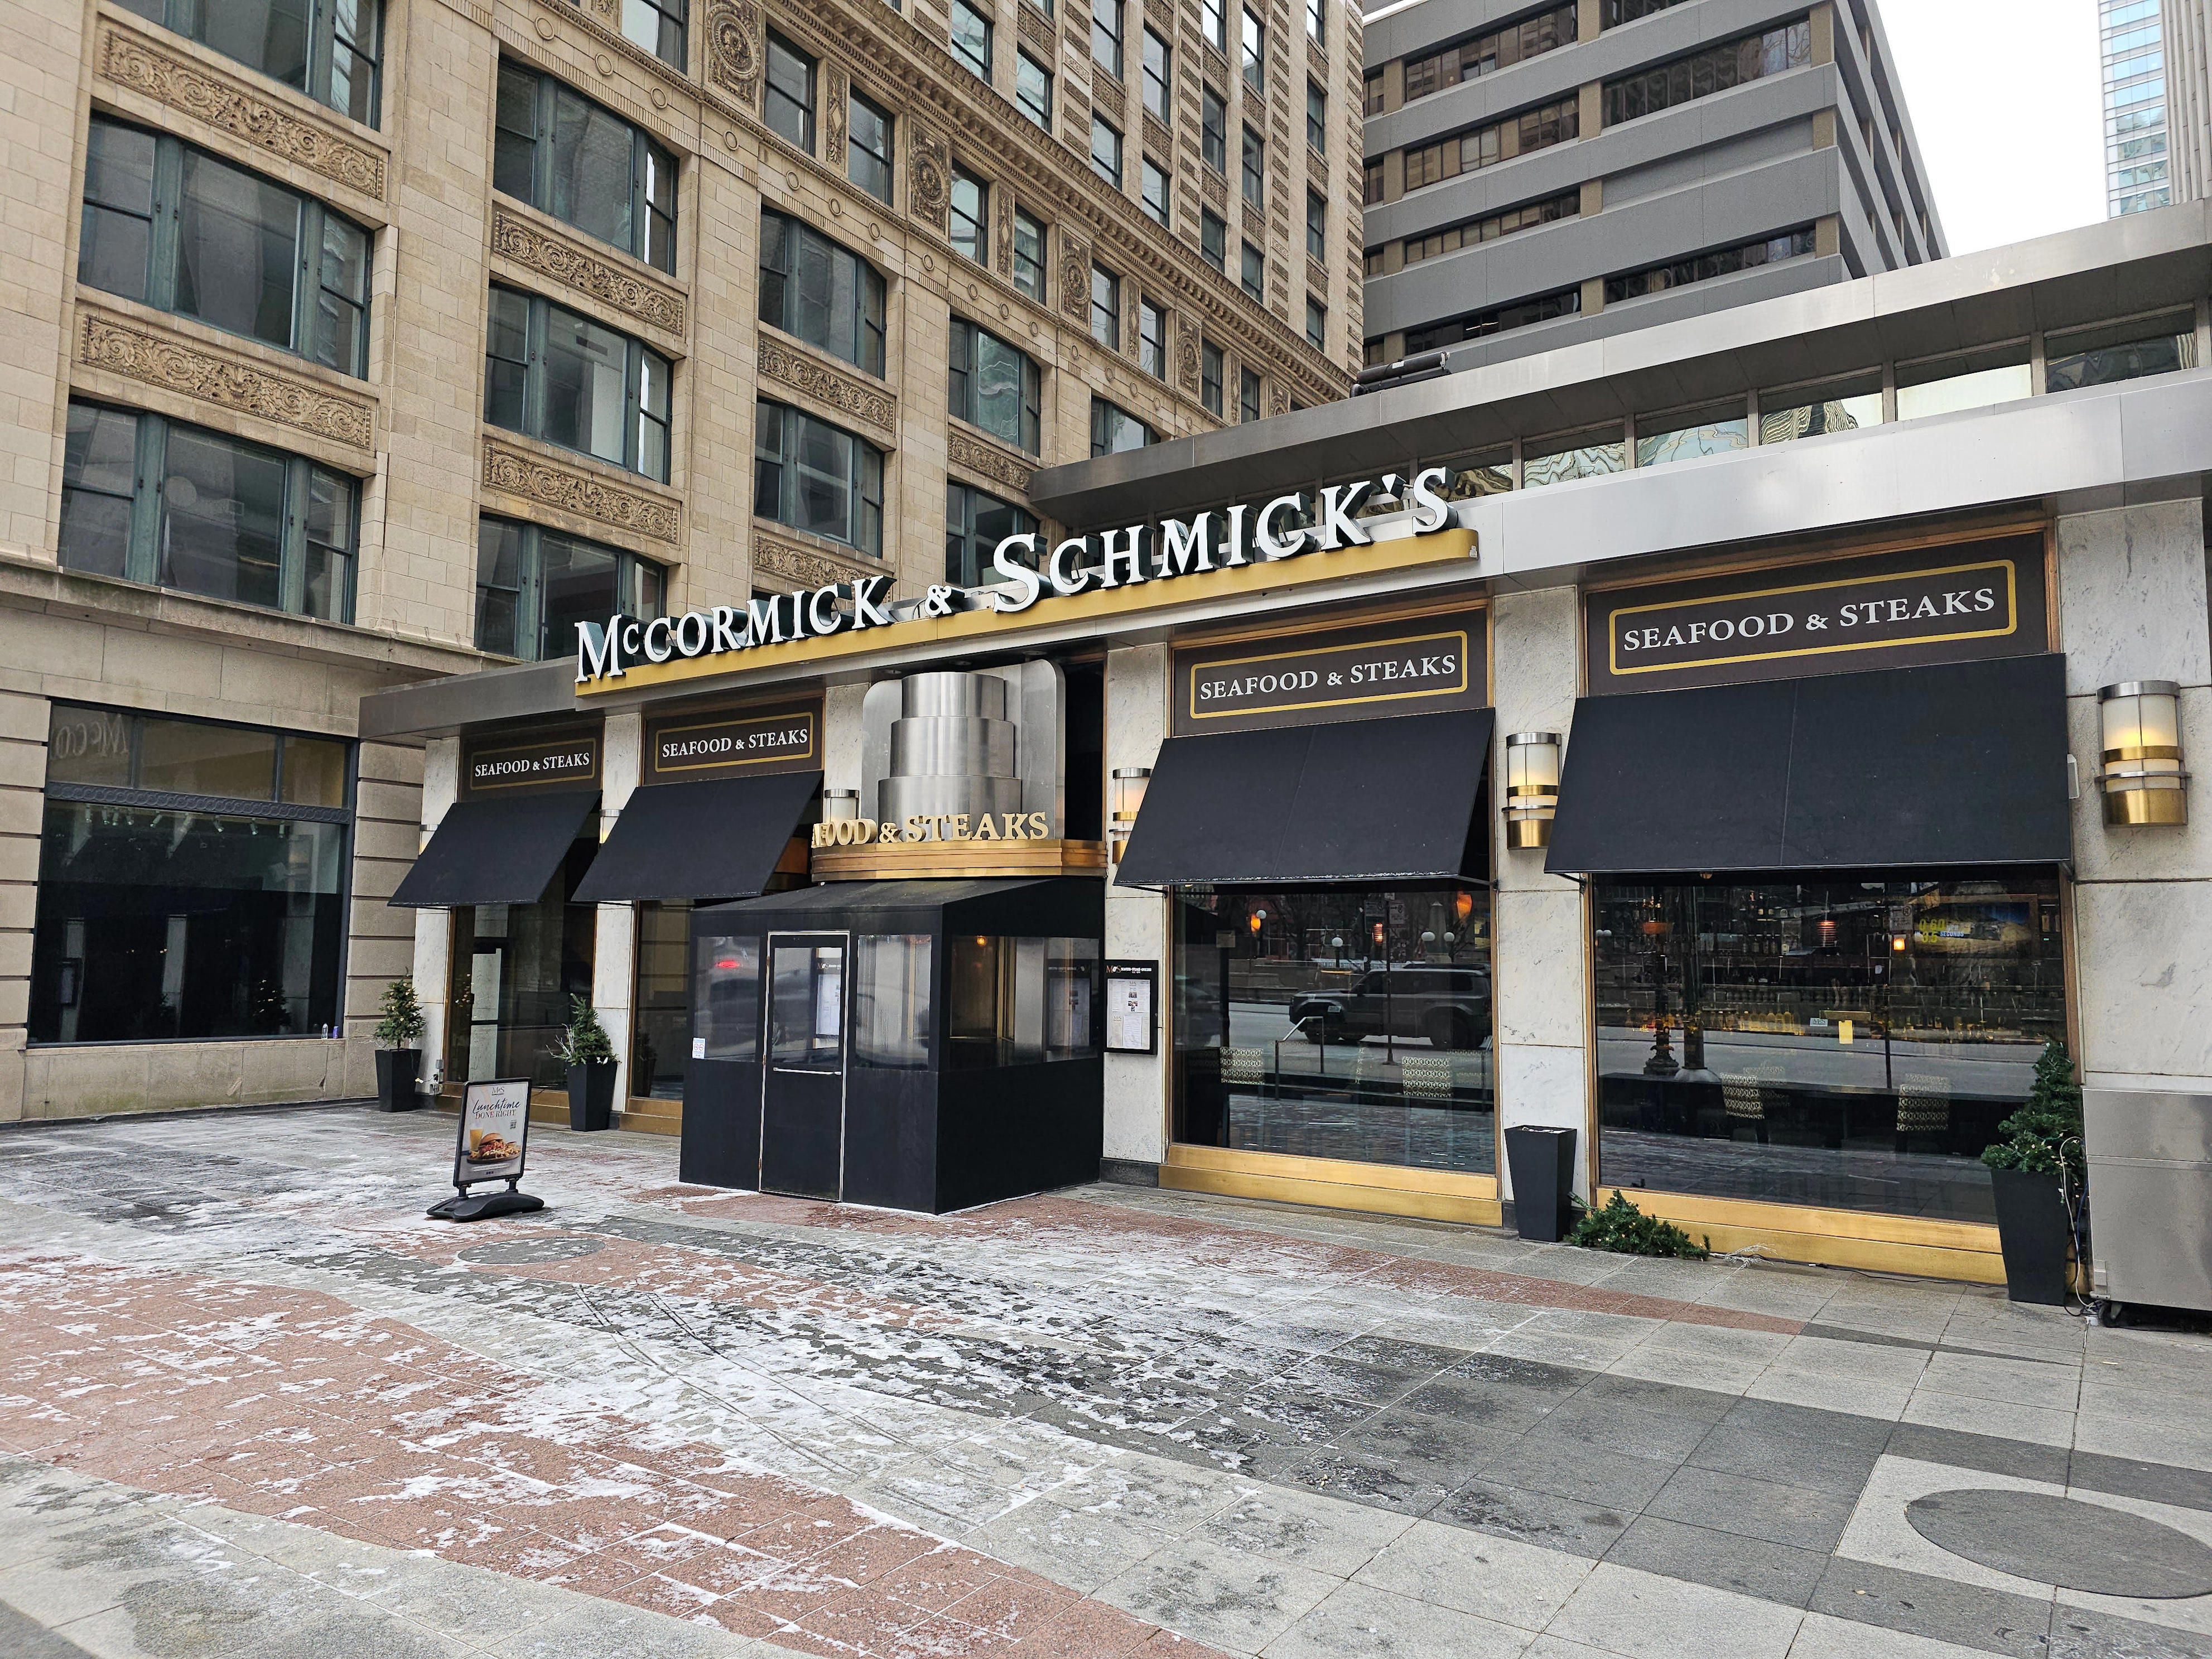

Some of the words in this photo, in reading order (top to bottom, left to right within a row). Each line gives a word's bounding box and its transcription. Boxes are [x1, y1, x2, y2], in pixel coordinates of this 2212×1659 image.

[924, 583, 953, 618] &
[992, 466, 1450, 614] SCHMICK'S
[1624, 613, 1792, 652] SEAFOOD
[1806, 614, 1829, 630] &
[1839, 587, 1994, 626] STEAKS
[1200, 671, 1319, 701] SEAFOOD
[1327, 672, 1343, 686] &
[1350, 654, 1456, 683] STEAKS
[662, 737, 732, 758] SEAFOOD
[735, 739, 745, 750] &
[748, 729, 808, 749] STEAKS
[475, 759, 530, 777] SEAFOOD
[532, 761, 541, 771] &
[542, 752, 590, 770] STEAKS
[879, 822, 899, 843] &
[905, 811, 1049, 842] STEAKS
[472, 1097, 521, 1113] Lunchtime
[475, 1111, 494, 1120] DONE
[495, 1109, 517, 1117] RIGHT
